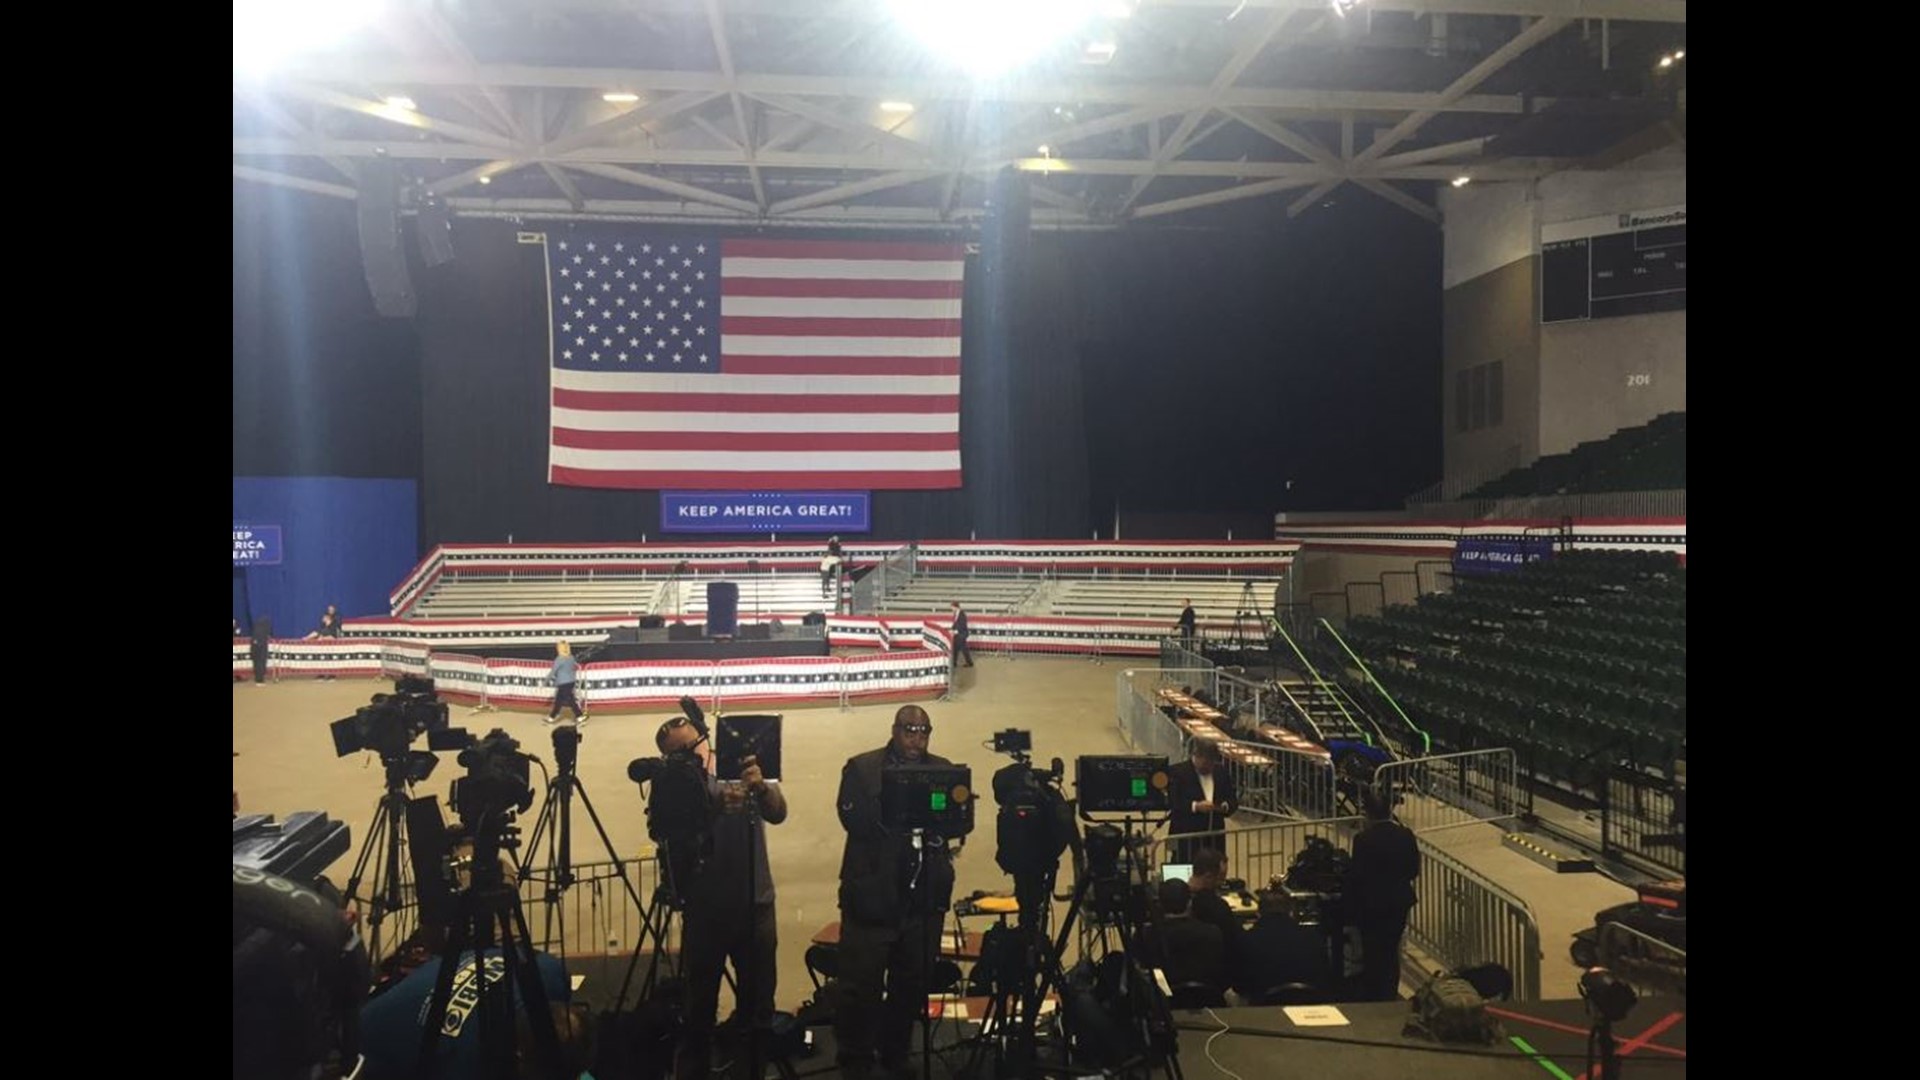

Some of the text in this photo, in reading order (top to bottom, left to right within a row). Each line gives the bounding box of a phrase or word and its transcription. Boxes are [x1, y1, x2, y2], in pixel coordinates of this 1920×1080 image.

[679, 504, 852, 517] KEEP AMERICA GREAT!
